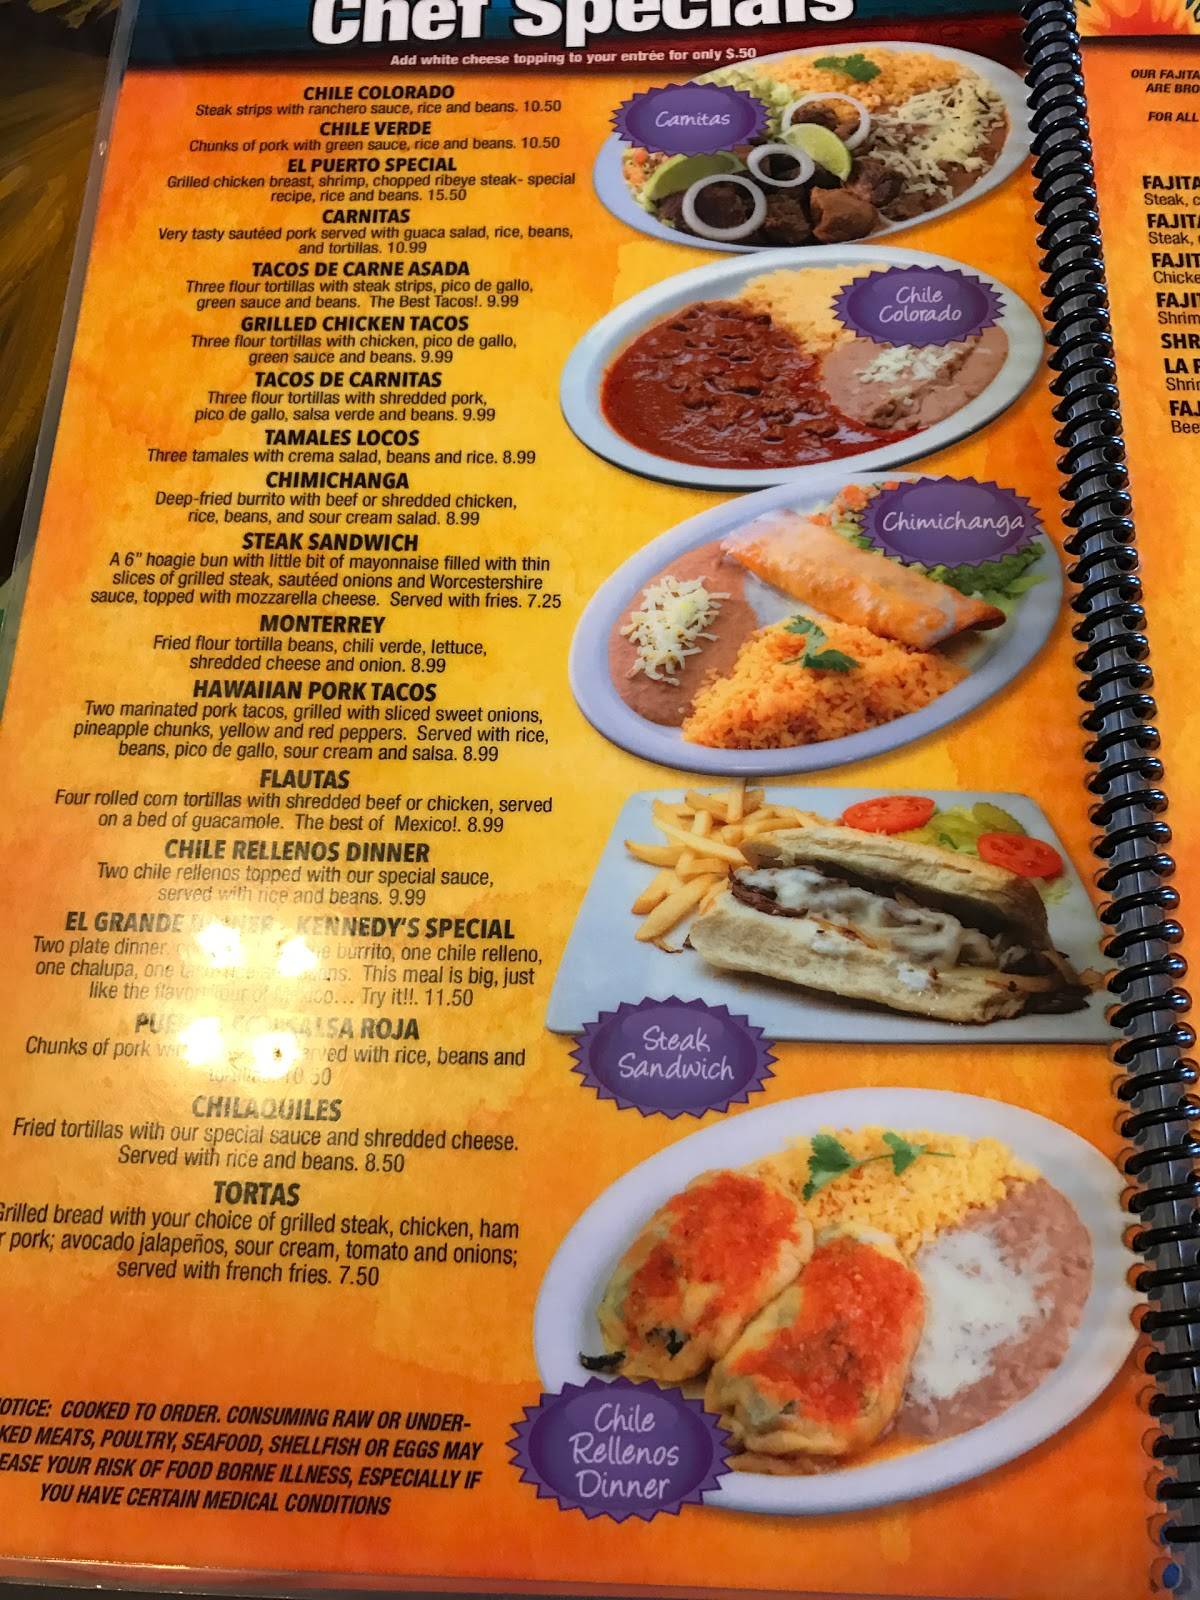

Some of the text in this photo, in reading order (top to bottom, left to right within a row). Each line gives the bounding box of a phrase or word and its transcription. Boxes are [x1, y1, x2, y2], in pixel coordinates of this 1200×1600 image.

[311, 0, 488, 44] Chef
[390, 48, 757, 65] Add white cheese topping to your entrée for only $.50
[1131, 69, 1156, 79] OUR
[303, 84, 454, 100] CHILE COLORADO
[1146, 83, 1171, 93] ARE
[195, 99, 561, 117] Steak strips with ranchero sauce, rice and beans. 10.50
[1148, 112, 1199, 122] FOR ALL
[319, 120, 431, 136] CHILE VERDE
[655, 111, 731, 128] Carnitas
[287, 156, 457, 173] EL PUERTO SPECIAL
[1144, 193, 1188, 207] Steak,
[322, 208, 410, 224] CARNITAS
[1149, 231, 1194, 246] Steak,
[252, 260, 470, 277] TACOS DE CARNE ASADA
[896, 286, 944, 304] Chile
[240, 315, 469, 332] GRILLED CHICKEN TACOS
[879, 305, 962, 323] Colorado
[191, 334, 516, 350] Three flour tortillas with chicken, pico de gallo,
[1164, 358, 1188, 374] LA
[255, 371, 442, 387] TACOS DE CARNITAS
[264, 429, 419, 446] TAMALES LOCOS
[265, 471, 409, 489] CHIMICHANGA
[882, 511, 1025, 537] Chimichanga
[242, 531, 418, 552] STEAK SANDWICH
[90, 588, 561, 608] sauce, topped with mozzarella cheese. Served with fries. 7.25
[259, 614, 386, 633] MONTERREY
[192, 679, 437, 702] HAWAIIAN PORK TACOS
[85, 699, 542, 724] Two marinated pork tacos, grilled with sliced sweet onions,
[259, 768, 350, 789] FLAUTAS
[165, 838, 430, 862] CHILE RELLENOS DINNER
[65, 911, 88, 931] EL
[94, 912, 184, 932] GRANDE
[425, 918, 515, 939] SPECIAL
[364, 965, 397, 983] This
[403, 966, 443, 984] meal
[450, 968, 463, 984] is
[468, 968, 499, 988] big,
[502, 968, 535, 989] just
[361, 1017, 420, 1040] ROJA
[642, 1025, 710, 1052] Steak
[618, 1052, 734, 1081] Sandwich
[191, 1095, 342, 1122] CHILAQUILES
[12, 1117, 518, 1150] Fried tortillas with our special sauce and shredded cheese.
[213, 1180, 300, 1207] TORTAS
[0, 1397, 471, 1432] OTICE: COOKED TO ORDER. CONSUMING RAW OR UNDER-
[594, 1403, 656, 1432] Chile
[34, 1426, 95, 1449] MEATS,
[100, 1428, 178, 1452] POULTRY,
[181, 1432, 263, 1455] SEAFOOD,
[268, 1435, 361, 1456] SHELLFISH
[364, 1438, 389, 1457] OR
[392, 1439, 440, 1459] EGGS
[442, 1440, 483, 1460] MAY
[569, 1431, 679, 1466] Rellenos
[46, 1455, 92, 1475] YOUR
[94, 1457, 137, 1477] RISK
[139, 1459, 164, 1478] OF
[165, 1459, 213, 1479] FOOD
[215, 1461, 277, 1482] BORNE
[278, 1463, 352, 1487] ILLNESS,
[357, 1466, 461, 1488] ESPECIALLY
[463, 1470, 482, 1489] IF
[576, 1469, 670, 1500] Dinner
[40, 1483, 391, 1515] YOU HAVE CERTAIN MEDICAL CONDITIONS
